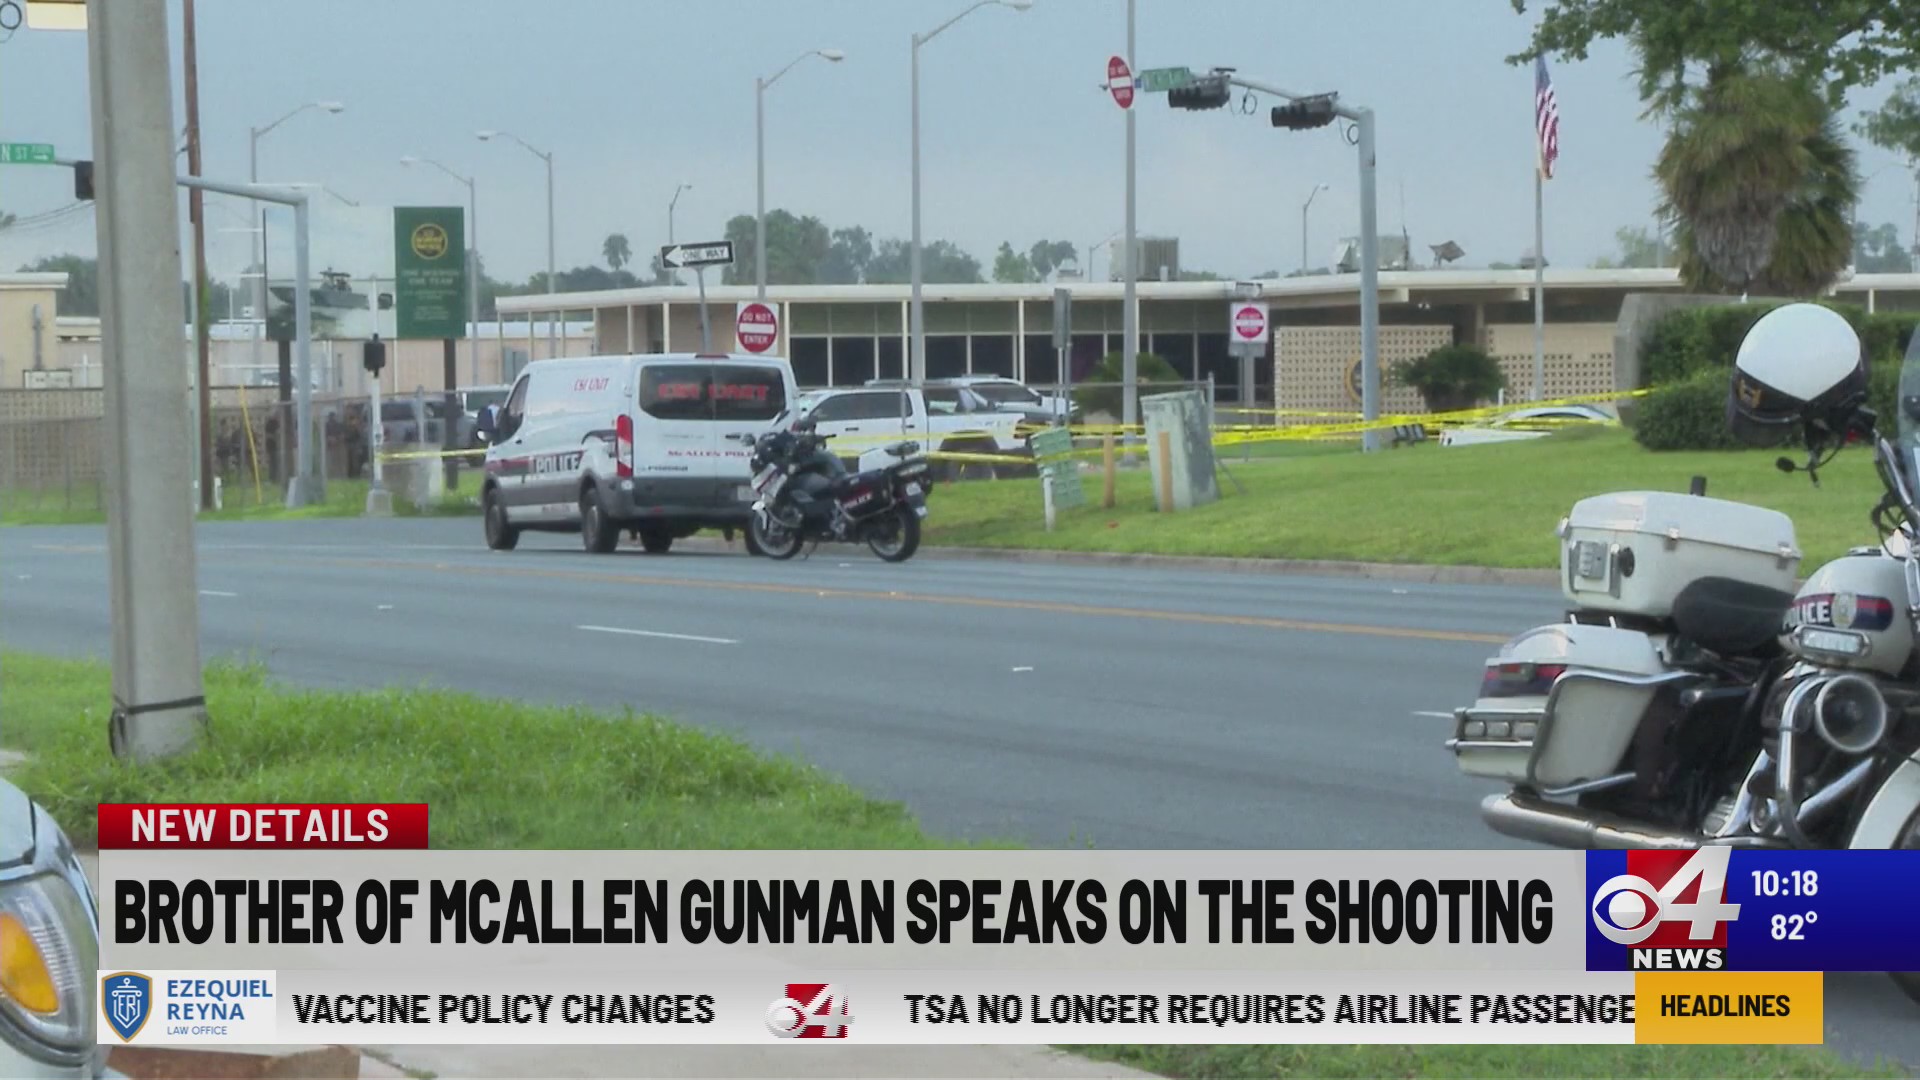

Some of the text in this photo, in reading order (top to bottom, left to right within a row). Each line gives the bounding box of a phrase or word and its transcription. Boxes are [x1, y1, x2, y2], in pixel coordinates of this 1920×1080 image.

[682, 246, 725, 262] ONE WAY
[742, 312, 772, 322] DO NOT
[743, 335, 768, 345] ENTER
[588, 377, 609, 391] UNIT
[658, 383, 768, 399] CSI UNIT
[536, 455, 580, 474] POLICE
